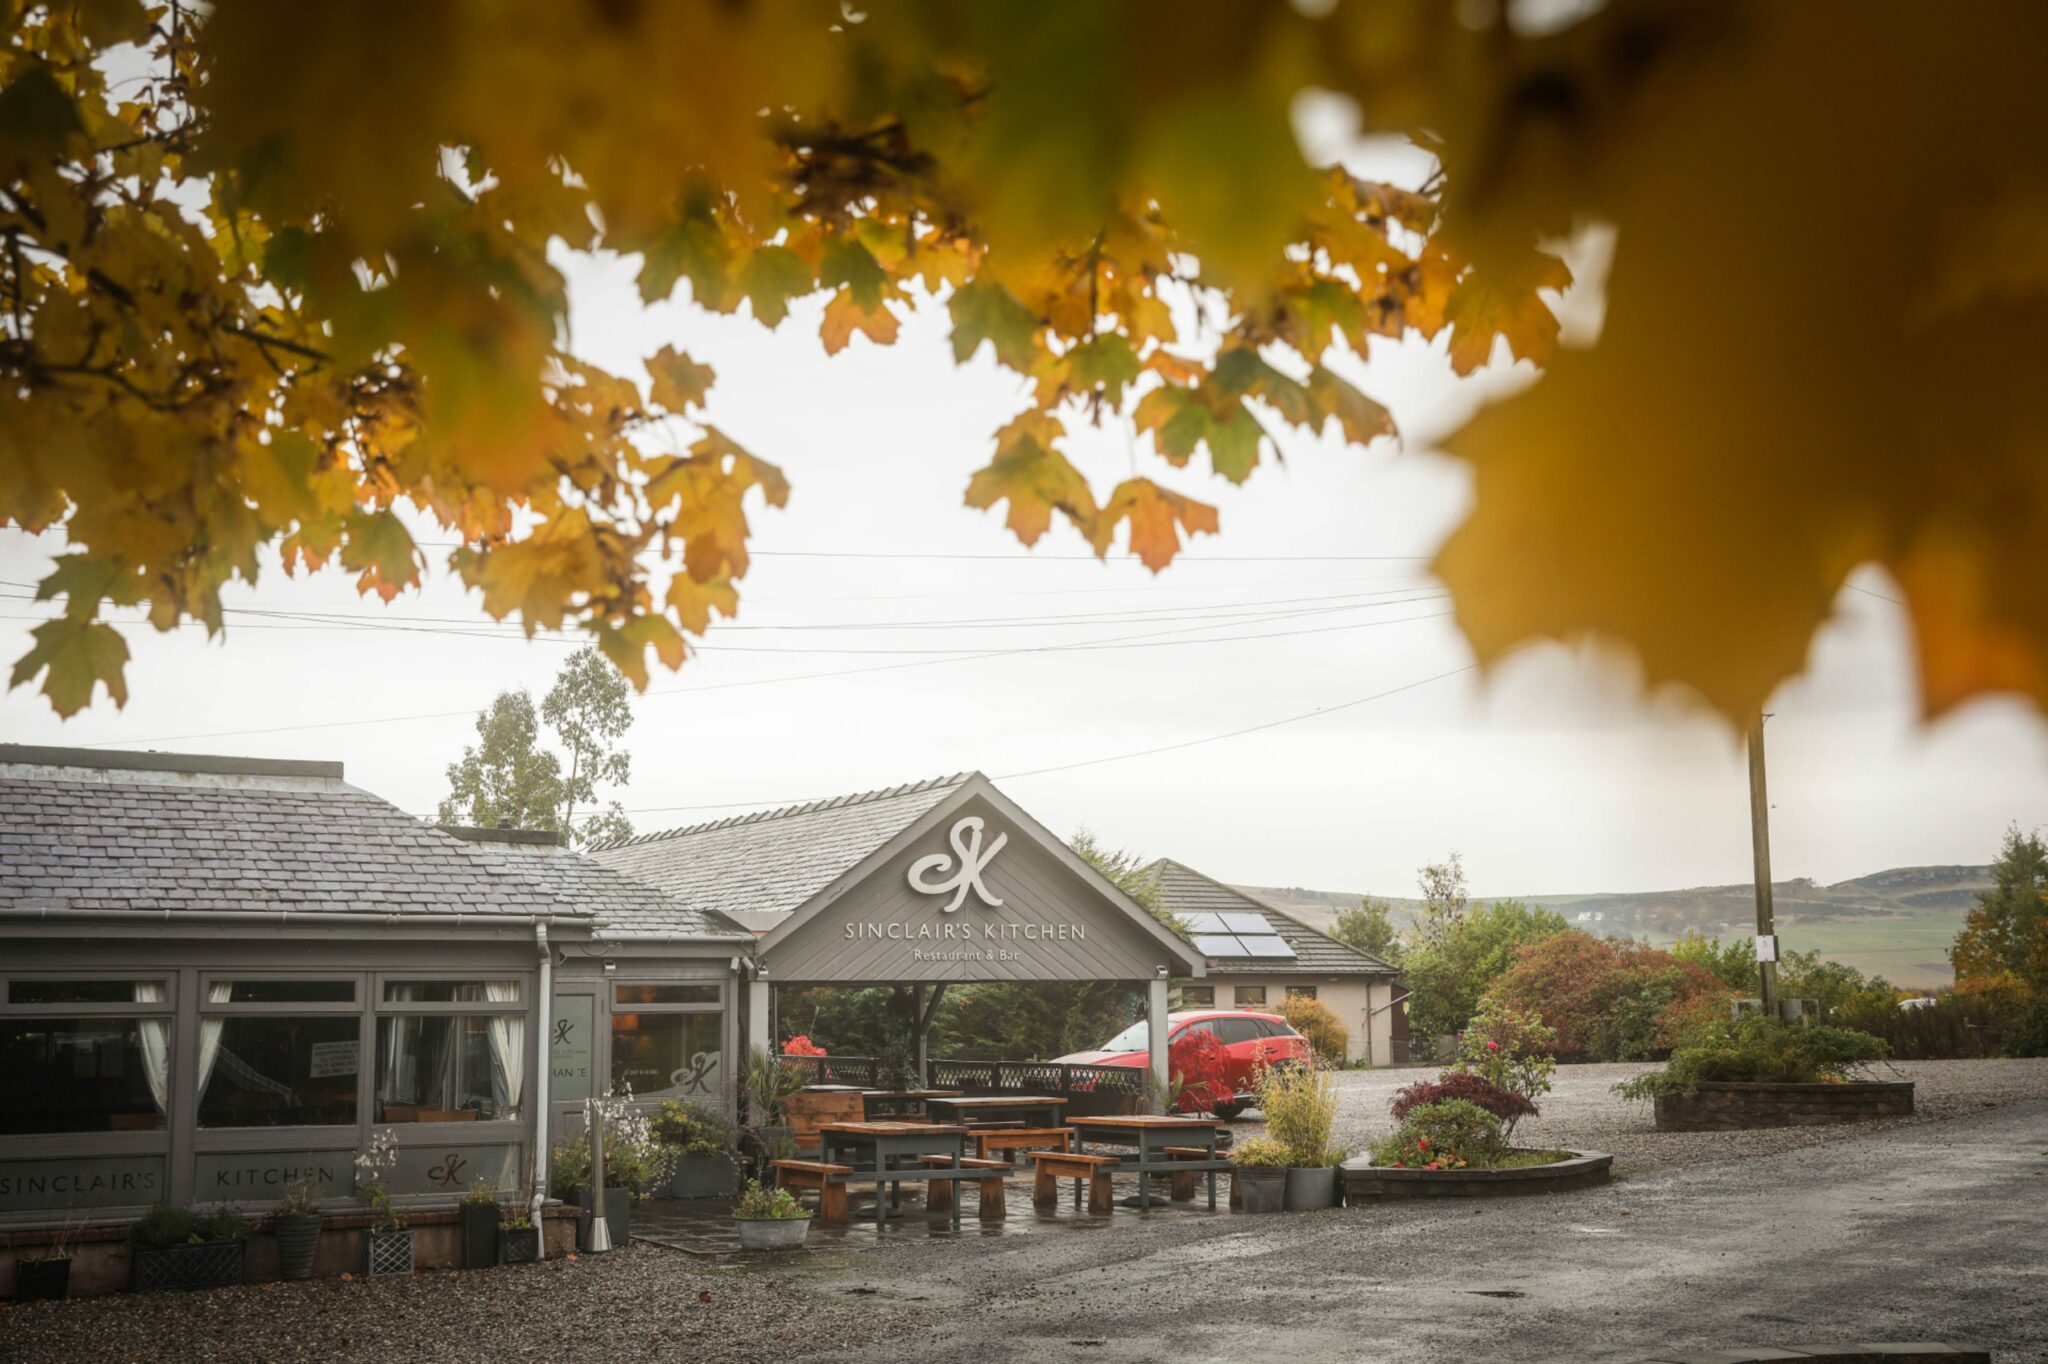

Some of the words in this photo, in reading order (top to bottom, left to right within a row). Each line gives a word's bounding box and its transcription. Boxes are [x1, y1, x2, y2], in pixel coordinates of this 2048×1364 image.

[844, 922, 971, 939] SINCLAIR'S
[984, 924, 1086, 940] KITCHEN
[914, 949, 981, 961] Restaurant
[986, 949, 994, 961] &
[1000, 949, 1020, 961] Bar
[0, 1173, 155, 1195] SINCLAIR'S
